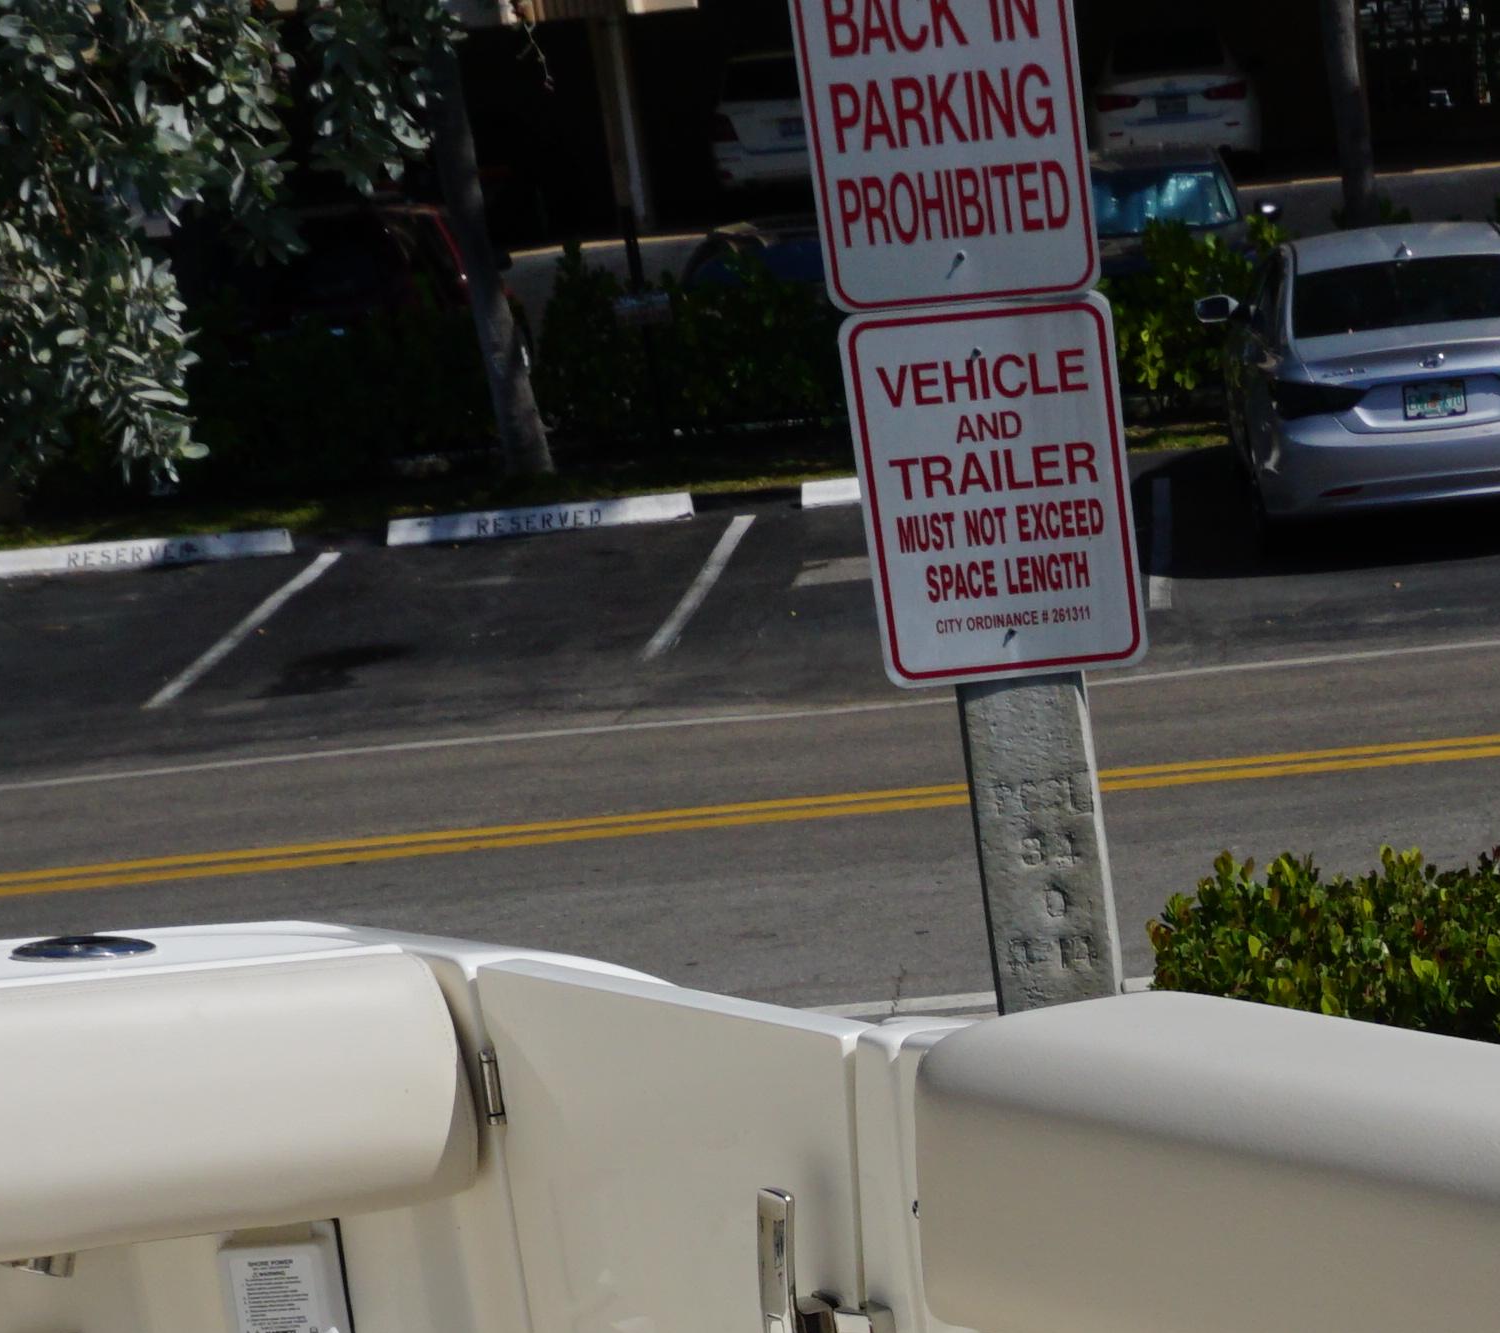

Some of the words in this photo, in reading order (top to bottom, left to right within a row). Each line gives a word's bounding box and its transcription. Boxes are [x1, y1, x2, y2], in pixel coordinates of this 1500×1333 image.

[824, 0, 969, 58] BACK
[989, 0, 1040, 42] IN
[829, 63, 1056, 153] PARKING
[836, 159, 1071, 248] PROHIBITED
[876, 348, 1089, 408] VEHICLE
[956, 410, 1023, 444] AND
[888, 441, 1099, 501] TRAILER
[896, 512, 955, 554] MUST
[964, 507, 1007, 547] NOT
[1015, 498, 1105, 542] EXCEED
[926, 559, 998, 603] SPACE
[1004, 551, 1091, 595] LENGTH
[936, 617, 963, 635] CITY
[966, 610, 1039, 632] ORDINANCE
[1041, 610, 1049, 624] #
[1052, 605, 1091, 623] 261311
